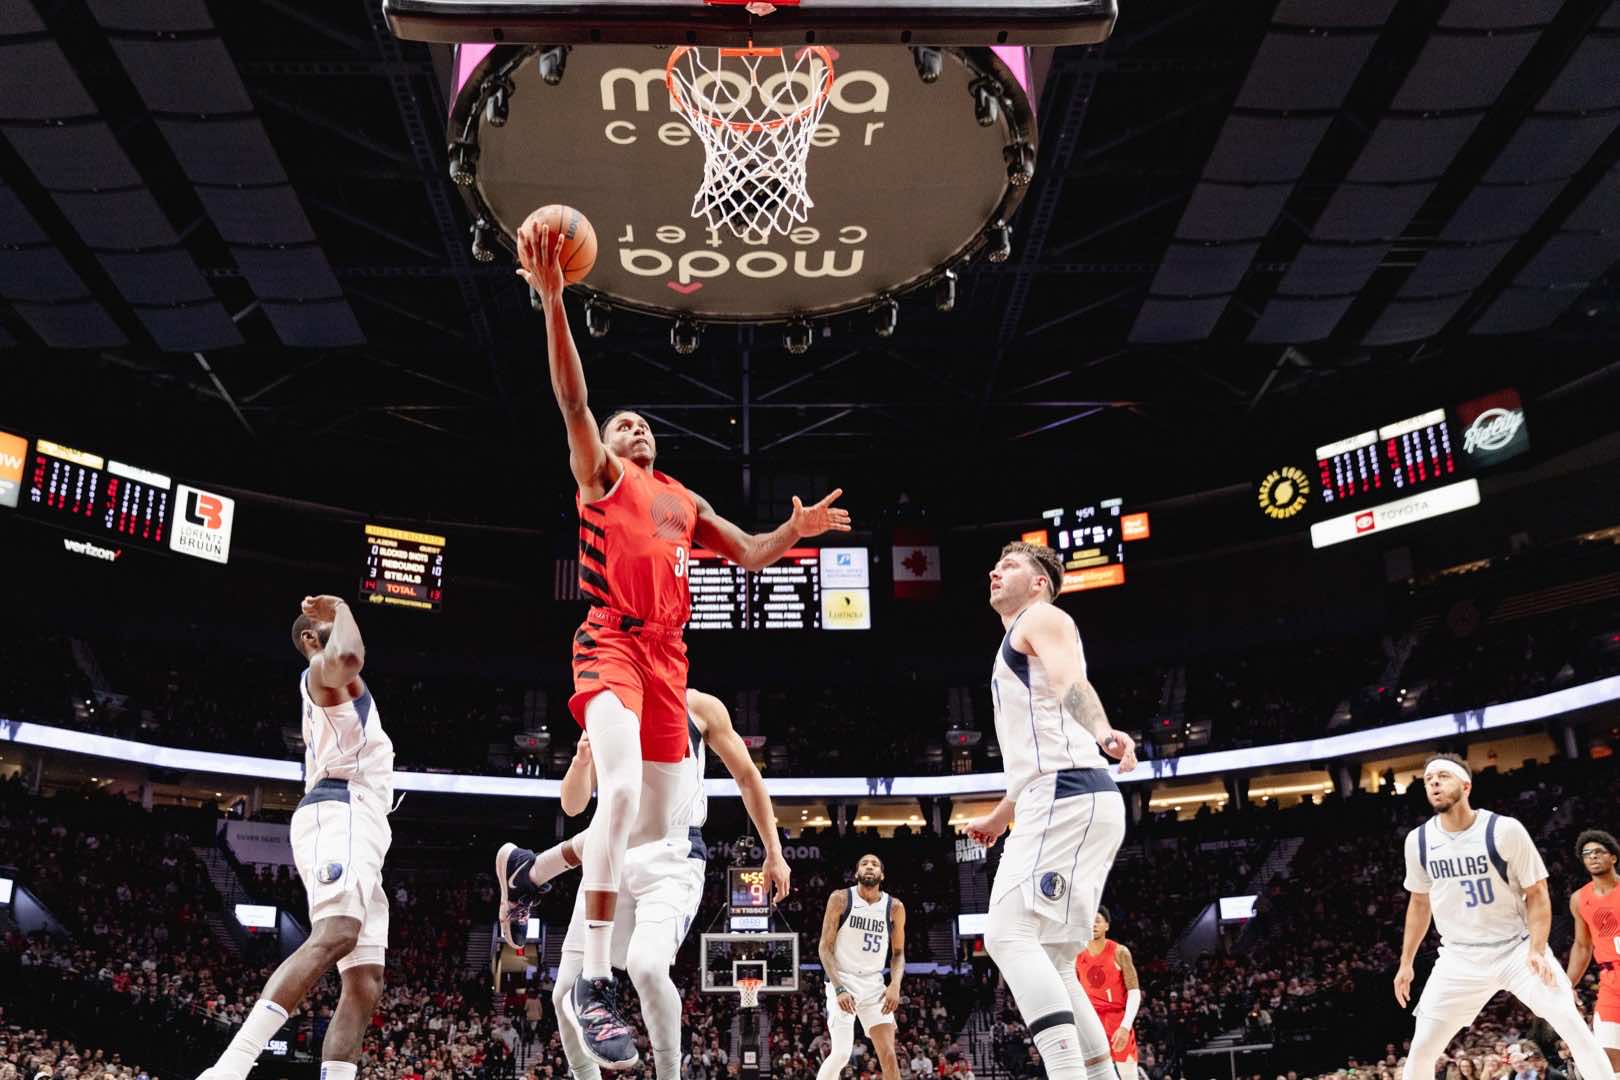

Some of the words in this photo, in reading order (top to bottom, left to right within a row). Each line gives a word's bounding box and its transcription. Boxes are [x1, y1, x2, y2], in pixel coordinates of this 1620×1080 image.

[600, 58, 889, 114] moda
[619, 248, 864, 284] moda
[1379, 501, 1429, 522] TOYOTA
[64, 539, 115, 561] verizon
[179, 535, 222, 555] BRUUN
[381, 559, 425, 573] REBOUNDS
[674, 546, 689, 577] 3
[384, 570, 422, 584] STEALS
[386, 584, 416, 596] TOTAL
[955, 846, 987, 863] PARTY
[1429, 855, 1488, 880] DALLAS
[750, 884, 763, 905] 9
[1460, 877, 1495, 908] 30
[849, 914, 885, 932] DALLAS
[862, 932, 881, 953] 55
[1105, 988, 1113, 1002] 1
